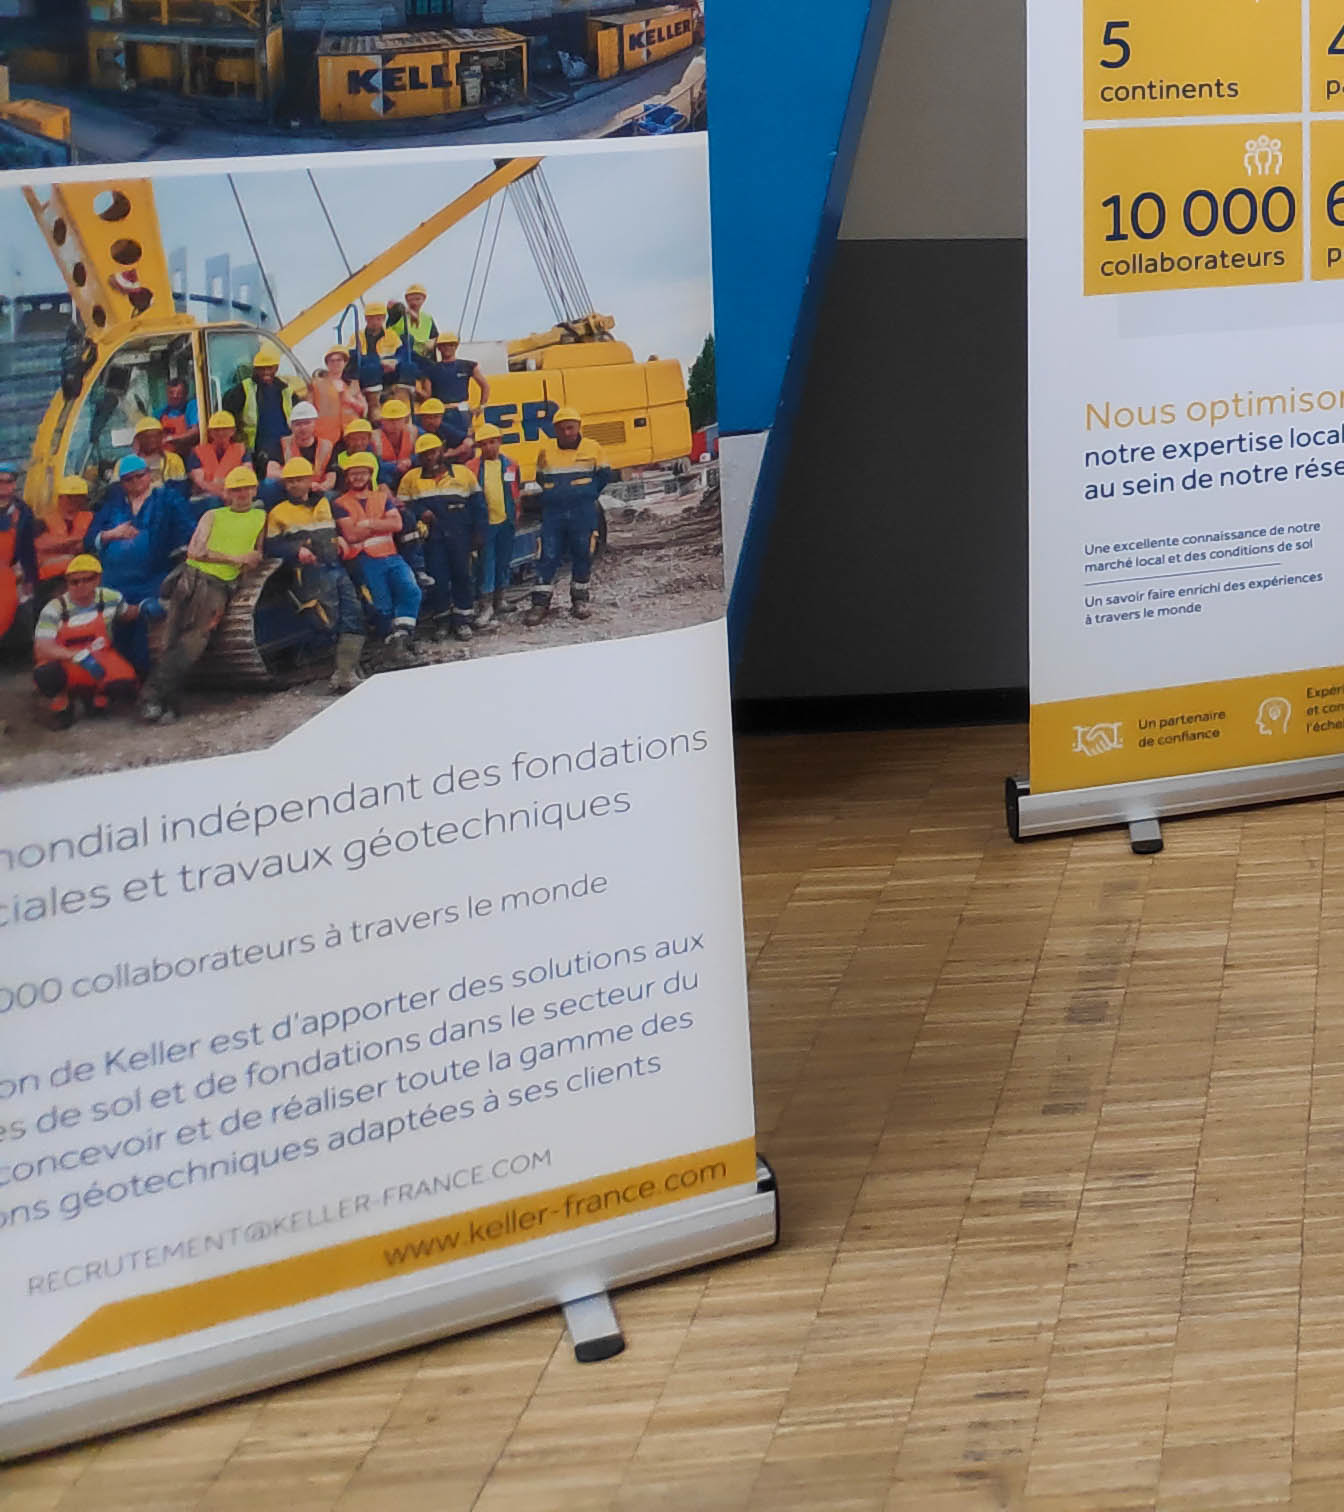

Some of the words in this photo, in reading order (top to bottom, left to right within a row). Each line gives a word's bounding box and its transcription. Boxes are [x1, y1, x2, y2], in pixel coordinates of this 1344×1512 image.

[628, 18, 690, 51] KELLER
[1099, 20, 1131, 69] 5
[1100, 78, 1240, 103] continents
[1102, 191, 1167, 242] 10
[1182, 186, 1297, 237] 000
[1100, 247, 1286, 278] collaborateurs
[1084, 401, 1177, 431] Nous
[1085, 443, 1156, 468] notre
[1162, 431, 1284, 464] expertise
[1084, 481, 1115, 501] au
[1122, 472, 1175, 497] sein
[1181, 467, 1213, 492] de
[1220, 463, 1288, 488] notre
[1084, 595, 1103, 609] Un
[1105, 591, 1145, 606] savoir
[1147, 588, 1177, 601] faire
[1178, 582, 1221, 598] enrichi
[1223, 581, 1246, 594] des
[1248, 572, 1324, 591] expériences
[1085, 614, 1093, 626] à
[1094, 608, 1141, 625] travers
[1143, 606, 1155, 621] le
[1157, 601, 1202, 617] monde
[161, 773, 423, 844] indépendant
[432, 763, 501, 796] des
[511, 729, 708, 782] fondations
[122, 868, 168, 904] et
[178, 844, 333, 894] travaux
[343, 791, 631, 872] géotechniques
[71, 933, 316, 999] collaborateurs
[324, 922, 342, 950] à
[349, 904, 460, 944] travers
[466, 894, 493, 920] le
[501, 872, 608, 913] monde
[49, 1059, 95, 1089] de
[105, 1038, 201, 1076] Keller
[209, 1021, 265, 1056] est
[271, 986, 441, 1042] d'apporter
[448, 974, 504, 1003] des
[511, 944, 647, 989] solutions
[655, 932, 705, 960] aux
[36, 1105, 81, 1134] de
[92, 1087, 141, 1123] sol
[150, 1081, 185, 1110] et
[195, 1072, 238, 1101] de
[245, 1032, 423, 1089] fondations
[427, 1013, 503, 1047] dans
[511, 1004, 535, 1029] le
[543, 980, 656, 1022] secteur
[663, 969, 700, 996] du
[176, 1116, 211, 1146] et
[220, 1107, 263, 1137] de
[271, 1079, 388, 1124] réaliser
[395, 1058, 481, 1095] toute
[488, 1047, 512, 1074] la
[519, 1023, 634, 1072] gamme
[641, 1010, 694, 1038] des
[59, 1136, 320, 1221] géotechniques
[327, 1099, 475, 1152] adaptées
[483, 1087, 500, 1114] à
[508, 1079, 559, 1108] ses
[566, 1055, 662, 1093] clients
[27, 1148, 553, 1297] RECRUTEMENT@KELLER-FRANCE.COM
[382, 1160, 728, 1267] www.keller-france.com
